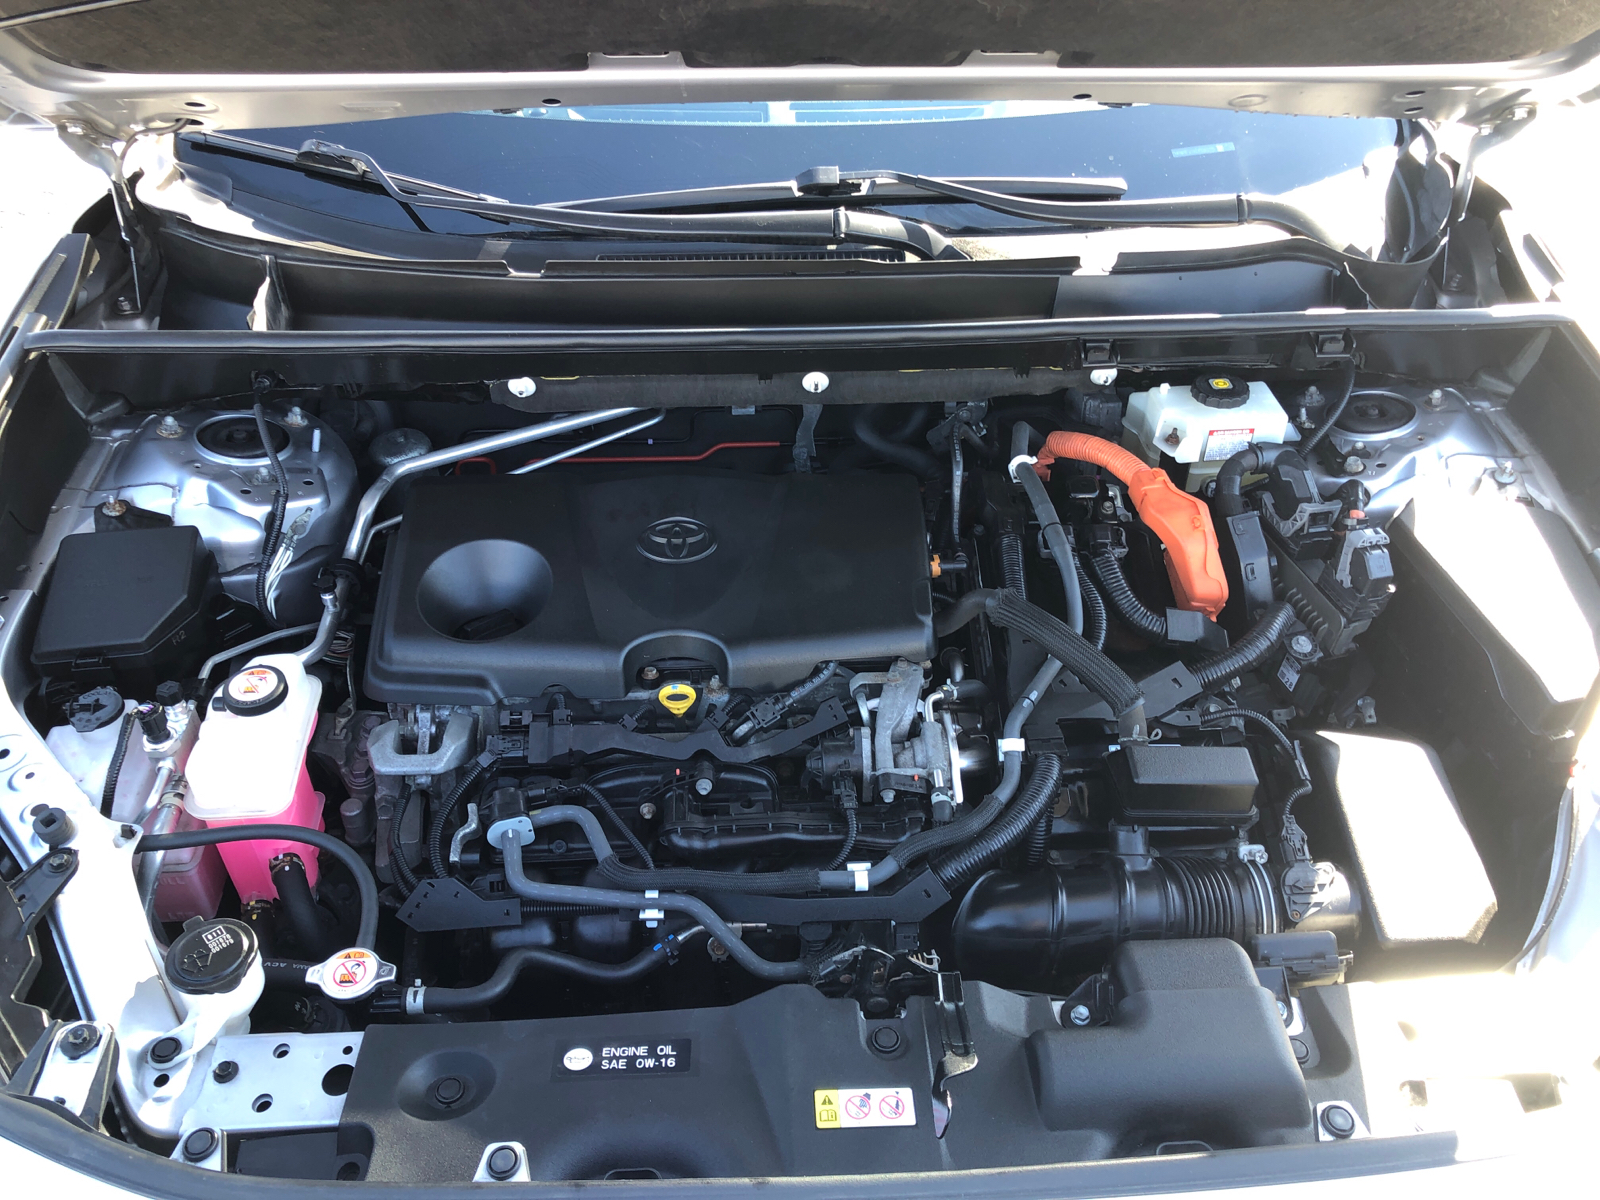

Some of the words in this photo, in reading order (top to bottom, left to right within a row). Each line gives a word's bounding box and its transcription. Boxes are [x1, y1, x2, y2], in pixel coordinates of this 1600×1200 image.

[602, 1046, 649, 1057] ENGINE
[657, 1045, 677, 1056] OIL
[601, 1059, 628, 1069] SAE
[636, 1058, 676, 1069] 0W-16
